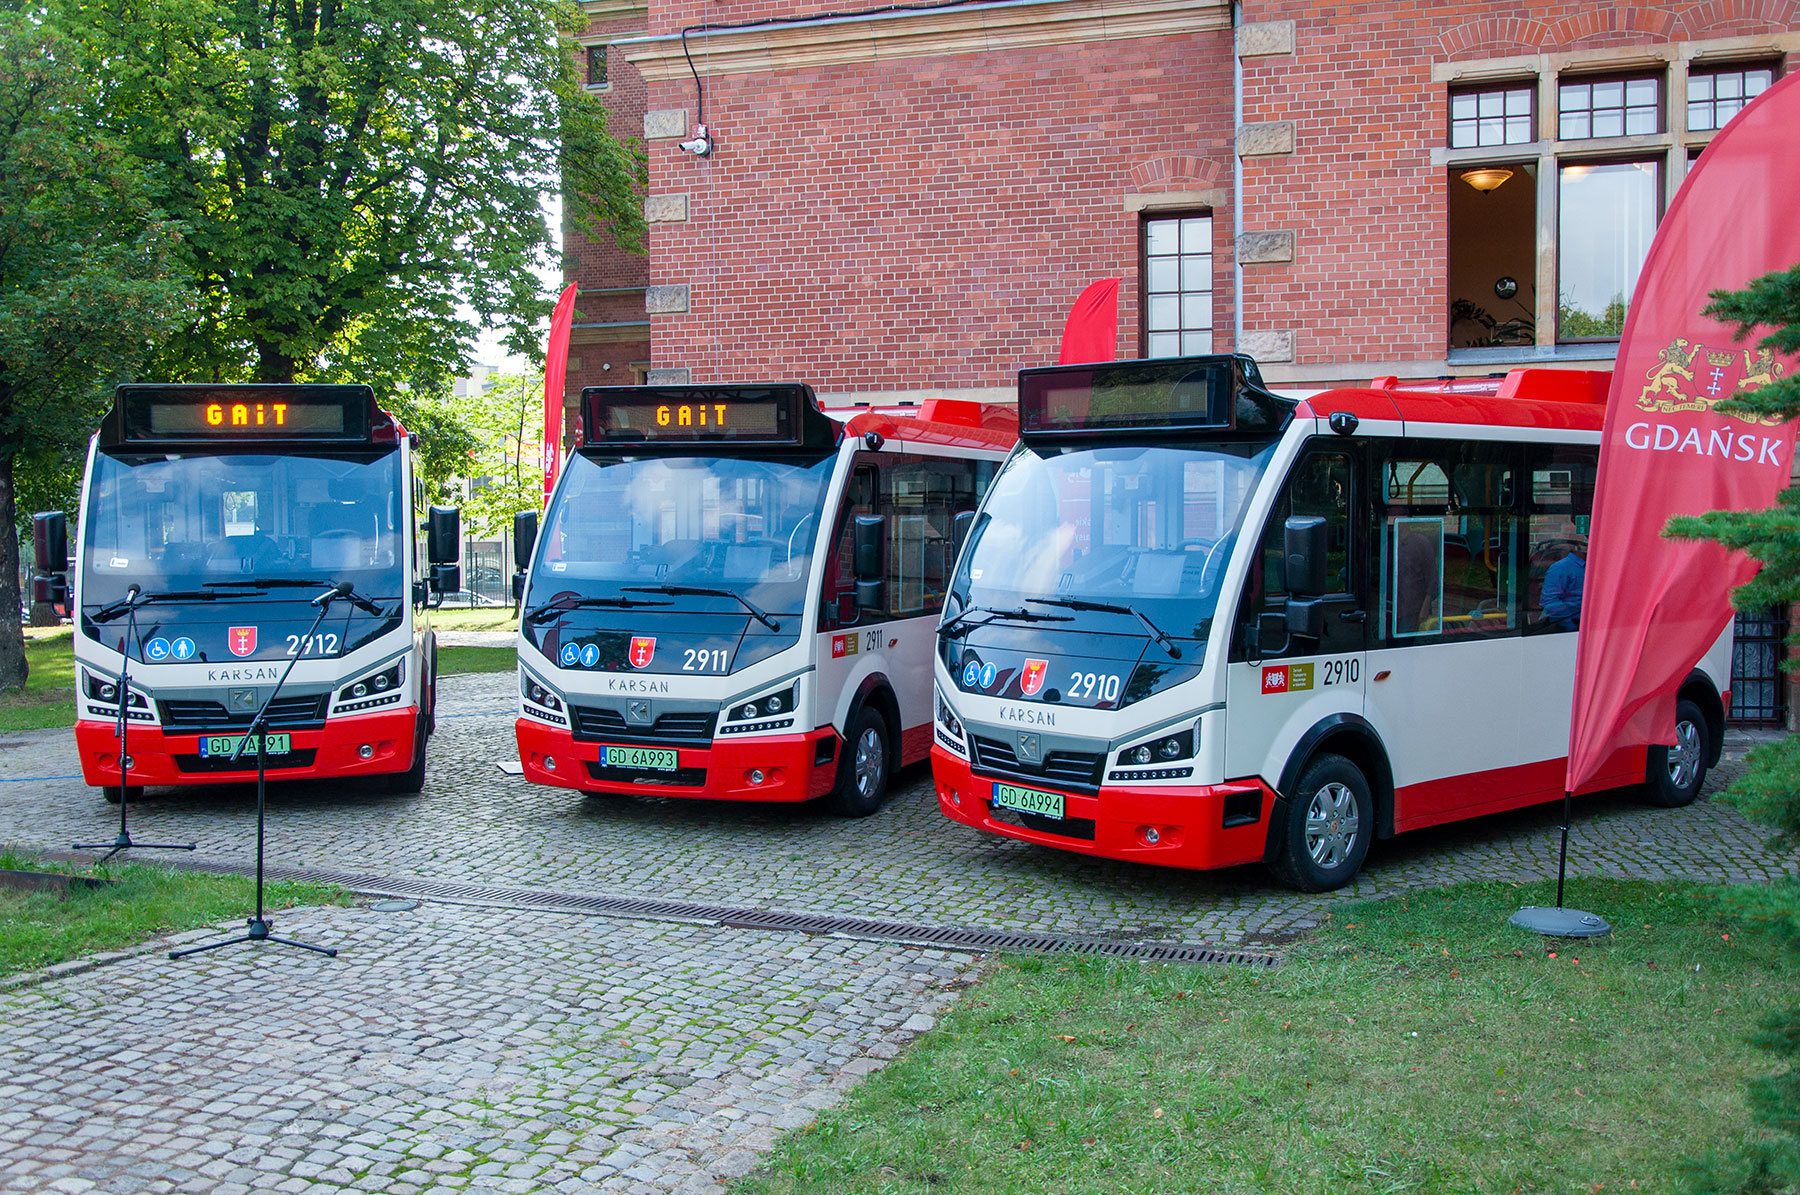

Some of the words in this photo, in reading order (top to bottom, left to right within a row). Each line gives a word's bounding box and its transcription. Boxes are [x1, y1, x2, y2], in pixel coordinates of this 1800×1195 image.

[1625, 422, 1783, 467] GDAŃSK
[286, 633, 338, 655] 2912
[866, 629, 883, 651] 2911
[682, 648, 728, 672] 2911
[208, 667, 278, 681] KARSAN
[1323, 658, 1360, 686] 2910
[608, 678, 669, 693] KARSAN
[1067, 671, 1120, 701] 2910
[999, 705, 1056, 727] KARSAN
[211, 738, 231, 753] GD
[237, 735, 285, 752] A91
[609, 748, 627, 764] GD
[631, 750, 674, 766] 6A993
[1000, 787, 1017, 805] GD
[1021, 791, 1060, 814] 6A994
